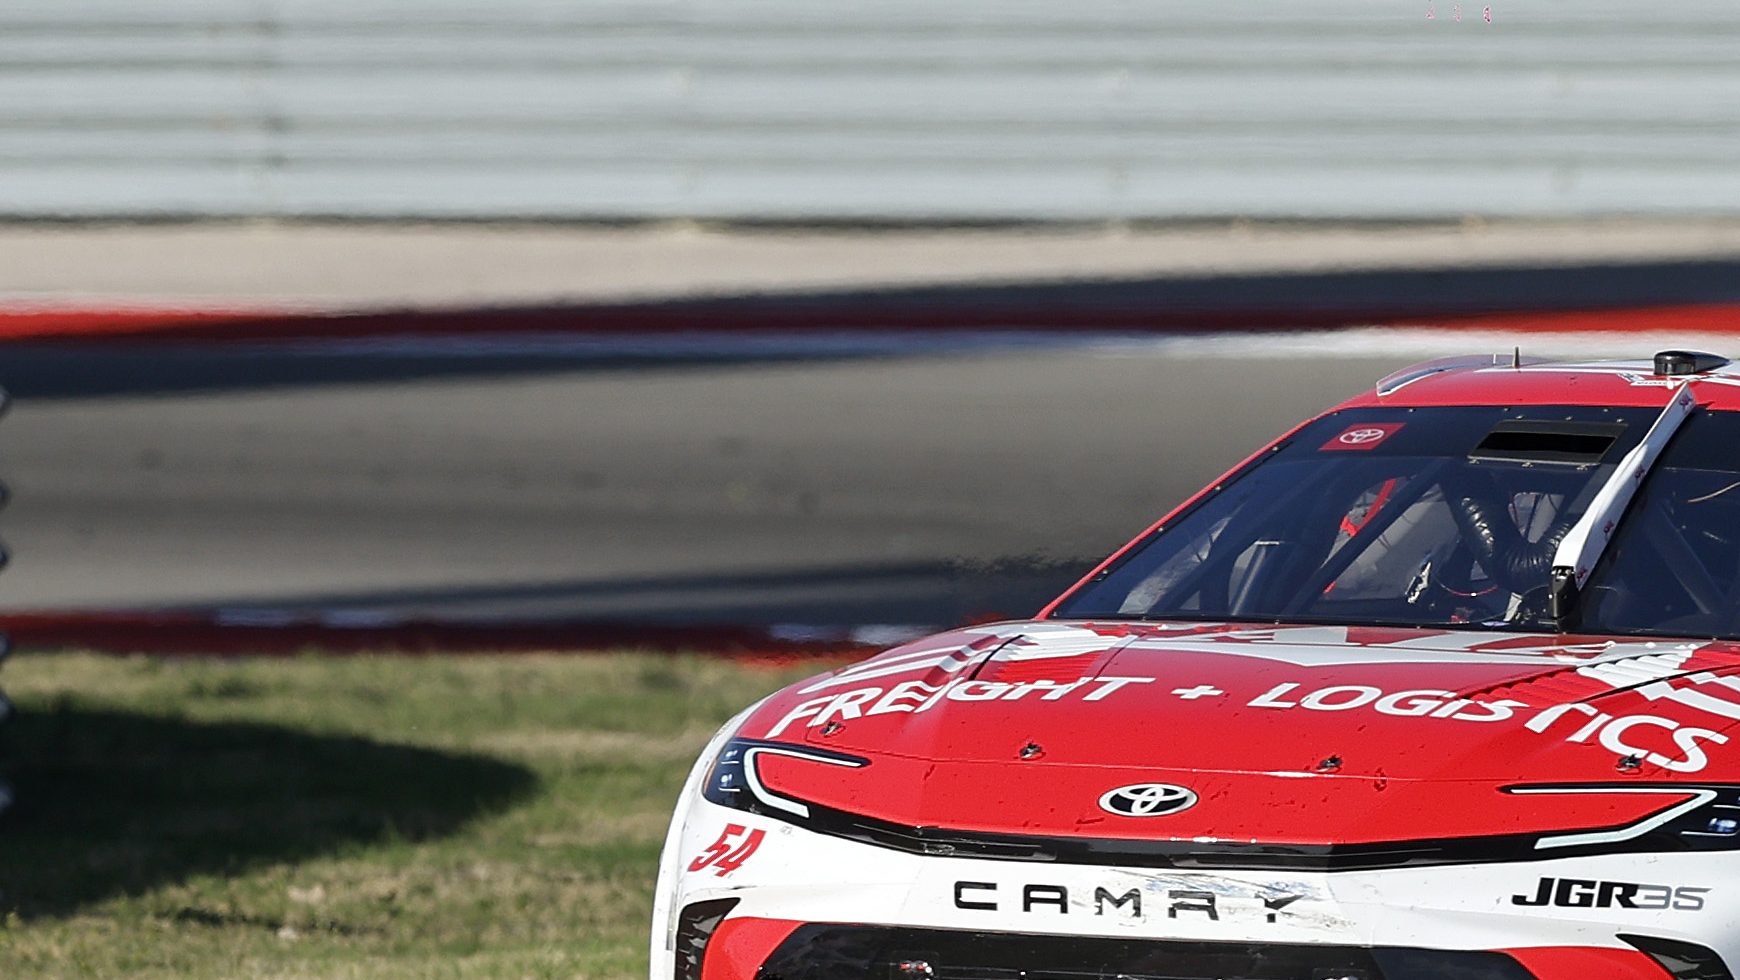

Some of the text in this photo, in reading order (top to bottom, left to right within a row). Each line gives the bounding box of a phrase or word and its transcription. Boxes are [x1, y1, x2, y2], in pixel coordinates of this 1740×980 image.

[763, 675, 1730, 774] FREIGHT + LOGISTICS
[686, 822, 768, 878] 54
[953, 880, 1305, 924] CAMRY
